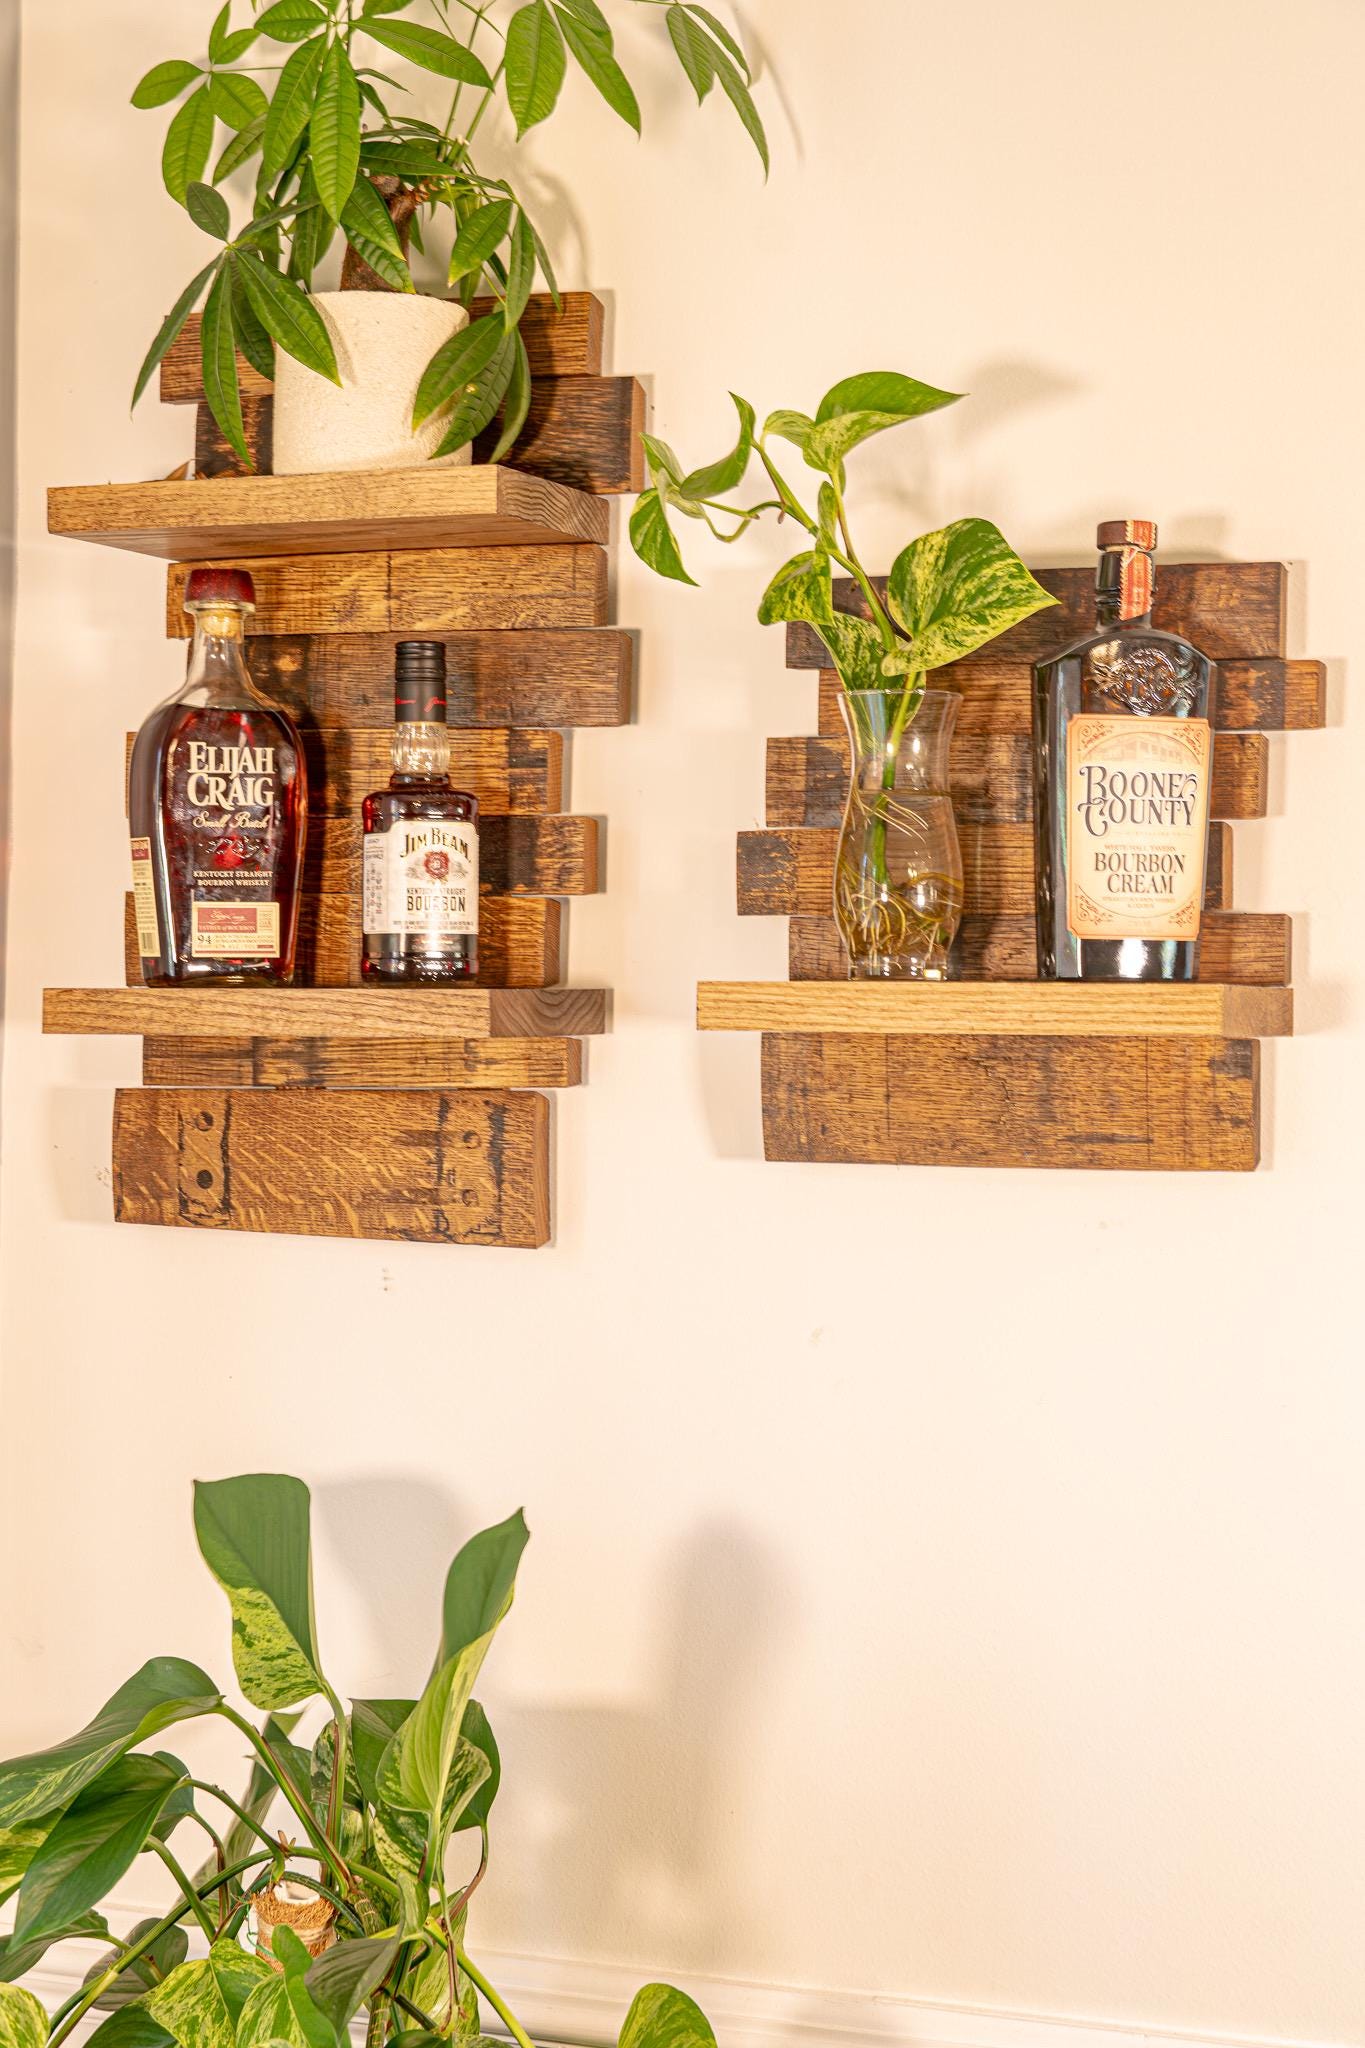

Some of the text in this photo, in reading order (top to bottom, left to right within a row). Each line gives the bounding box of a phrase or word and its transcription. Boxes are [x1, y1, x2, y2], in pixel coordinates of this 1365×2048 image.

[187, 741, 276, 779] ELIJAH
[187, 773, 275, 811] CRAIG
[1079, 765, 1197, 805] BOONE
[193, 811, 232, 829] Small
[1077, 797, 1196, 836] COUNTY
[400, 827, 469, 859] JIM BEAM
[193, 870, 273, 878] KENTUCKY STRAIGHT
[1094, 852, 1186, 874] BOURBON
[197, 879, 234, 887] BOURBON
[1107, 873, 1174, 894] CREAM
[197, 934, 212, 945] 94
